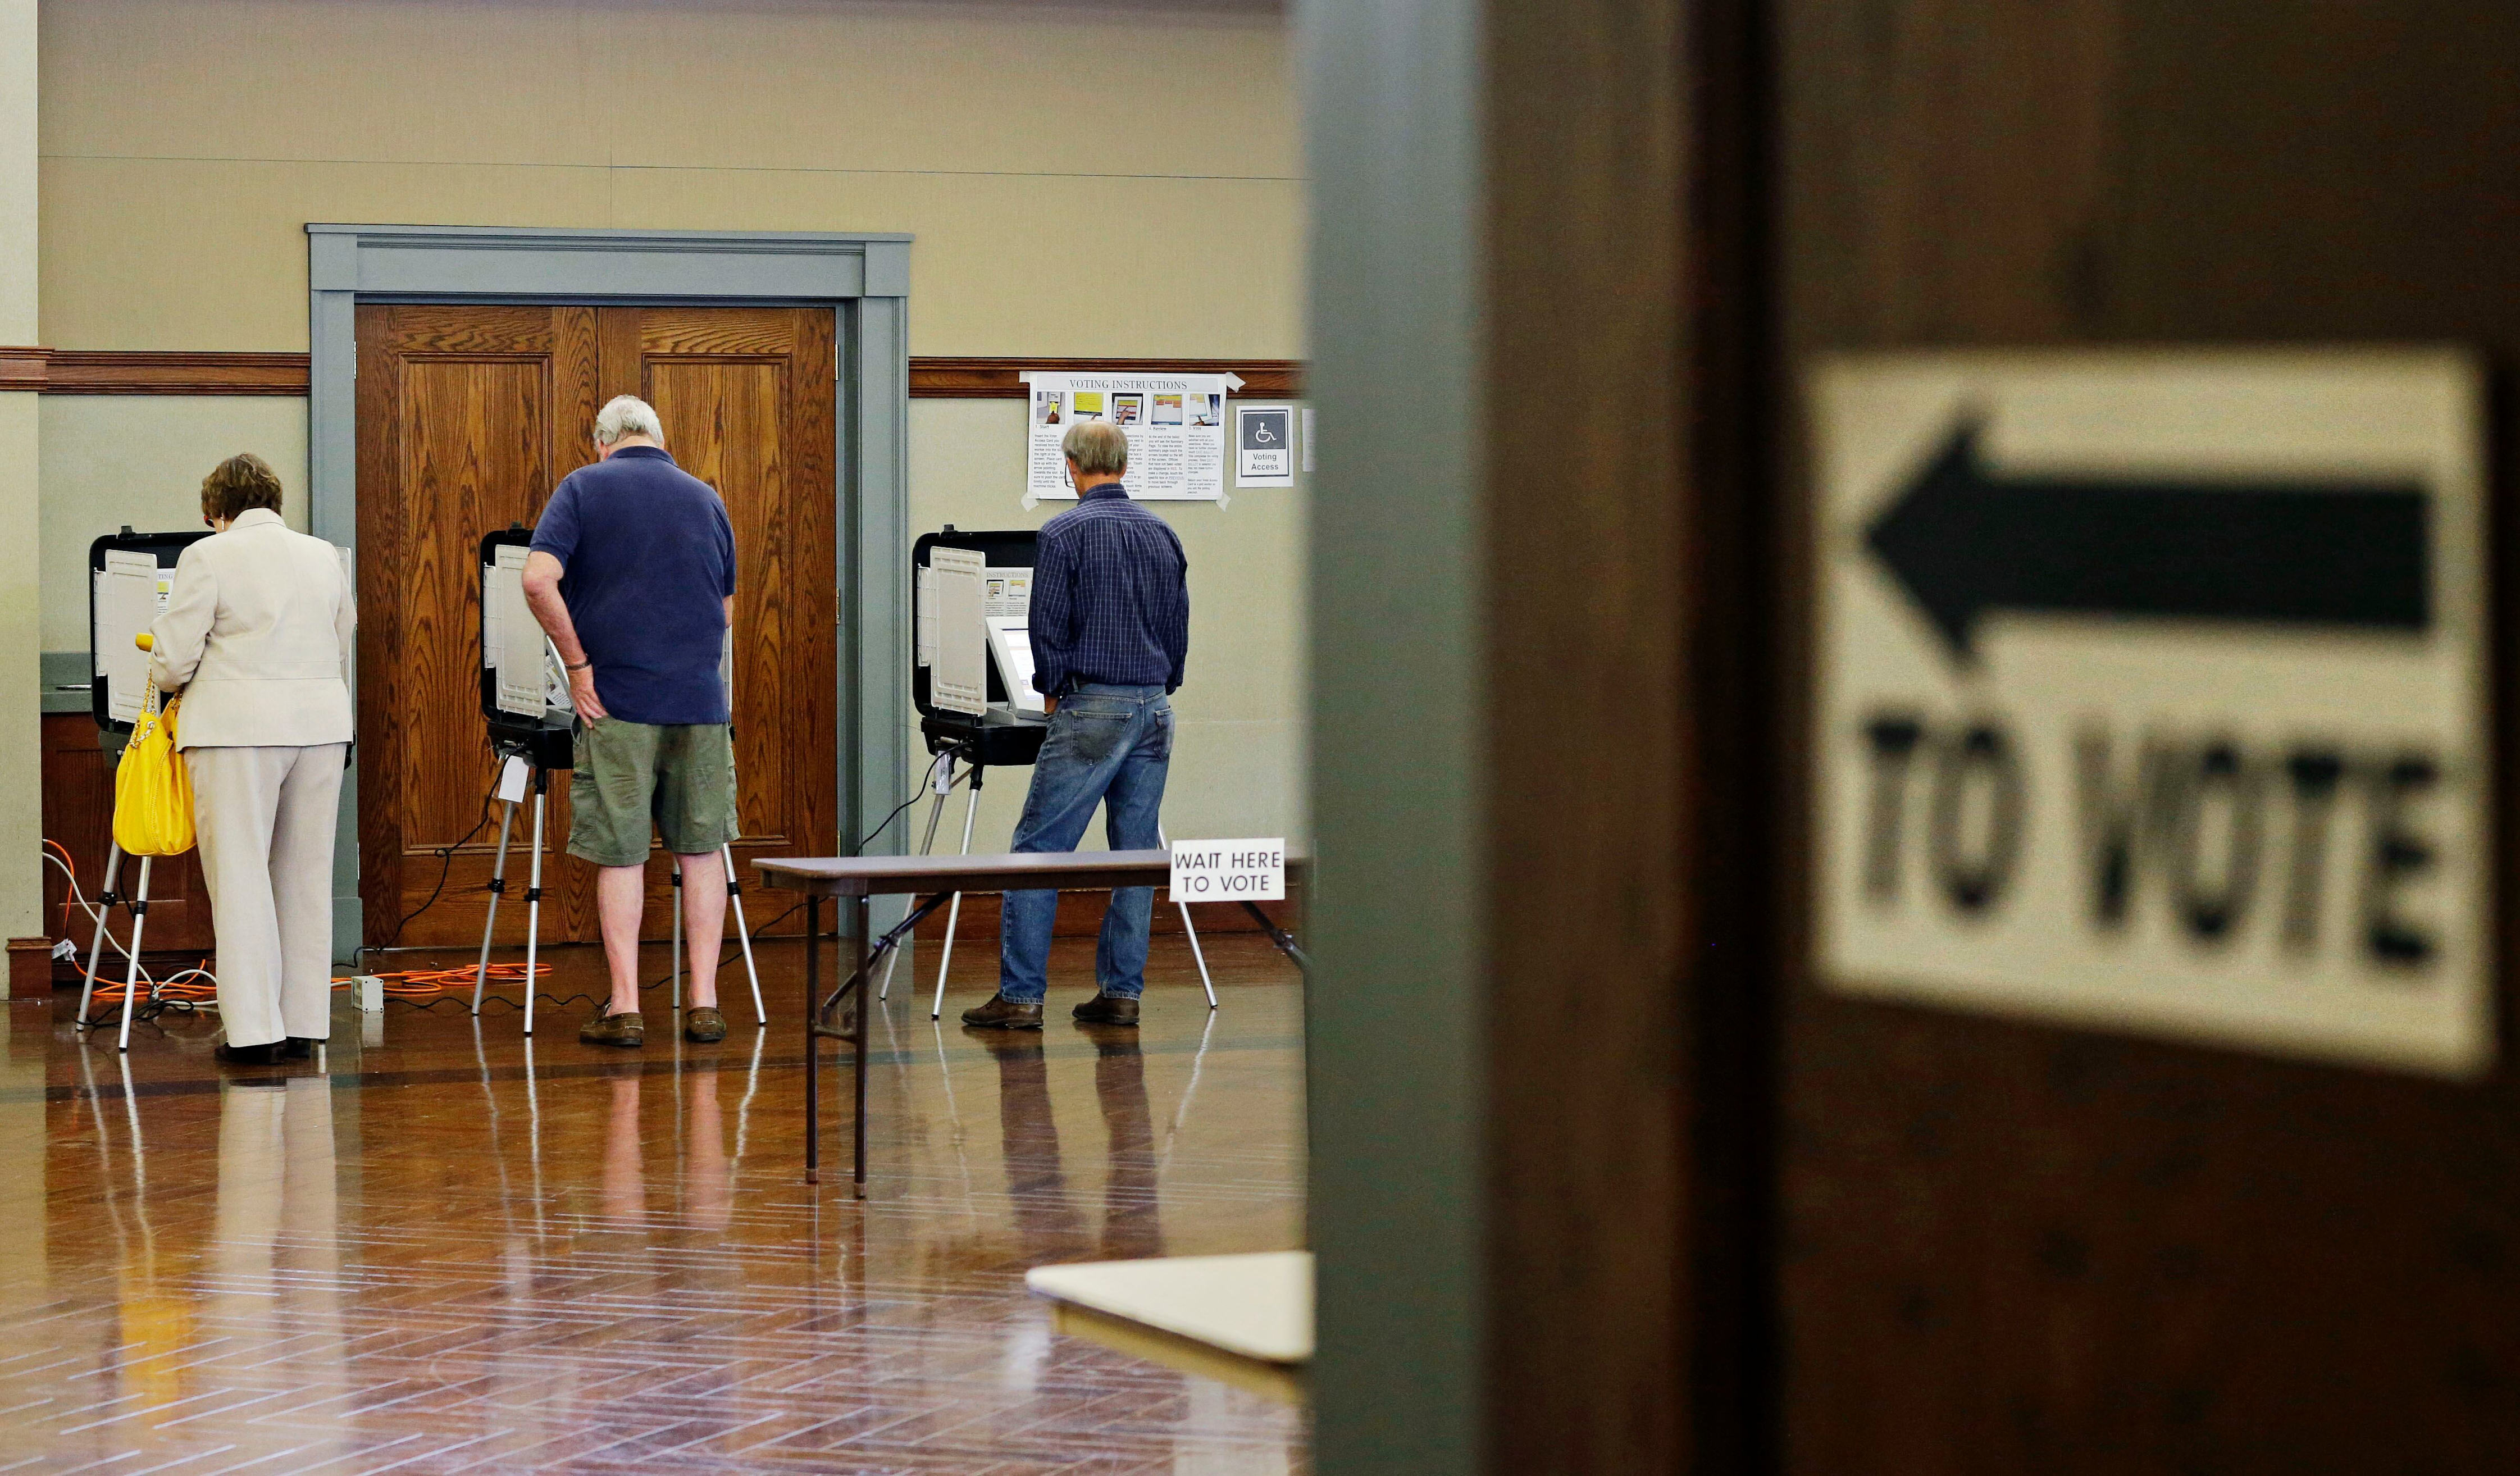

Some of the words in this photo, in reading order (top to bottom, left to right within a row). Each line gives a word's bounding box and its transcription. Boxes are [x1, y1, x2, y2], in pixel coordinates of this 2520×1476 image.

[1070, 380, 1109, 388] VOTING
[1113, 380, 1187, 389] INSTRUCTIONS
[1863, 713, 2025, 920] TO
[2075, 722, 2442, 968] VOTE
[1175, 853, 1222, 869] WAIT
[1232, 852, 1280, 868] HERE
[1183, 876, 1209, 893] TO
[1220, 875, 1269, 891] VOTE
